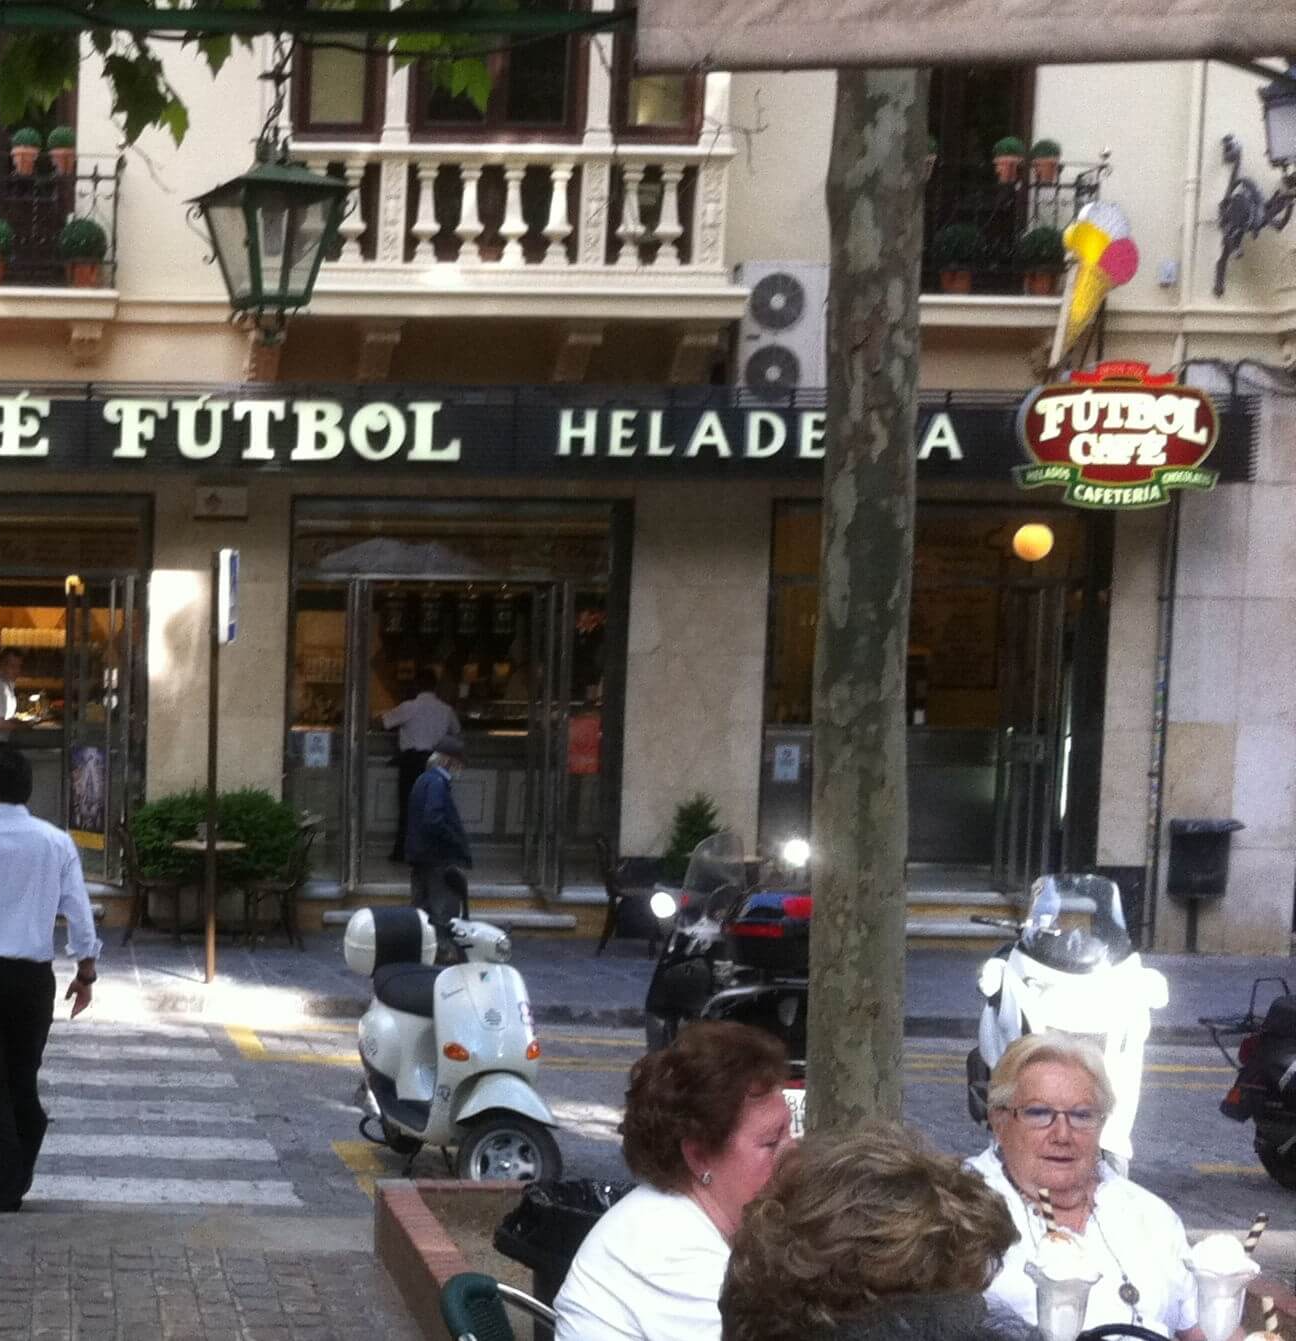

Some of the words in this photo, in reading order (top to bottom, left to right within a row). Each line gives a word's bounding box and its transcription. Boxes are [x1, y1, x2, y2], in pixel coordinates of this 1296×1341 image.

[104, 393, 461, 462] FÚTBOL
[556, 409, 964, 460] HELADEA
[1035, 389, 1209, 445] FÚTBOL
[1069, 428, 1167, 465] CAFÉ
[1073, 484, 1162, 504] CAFETERÍA
